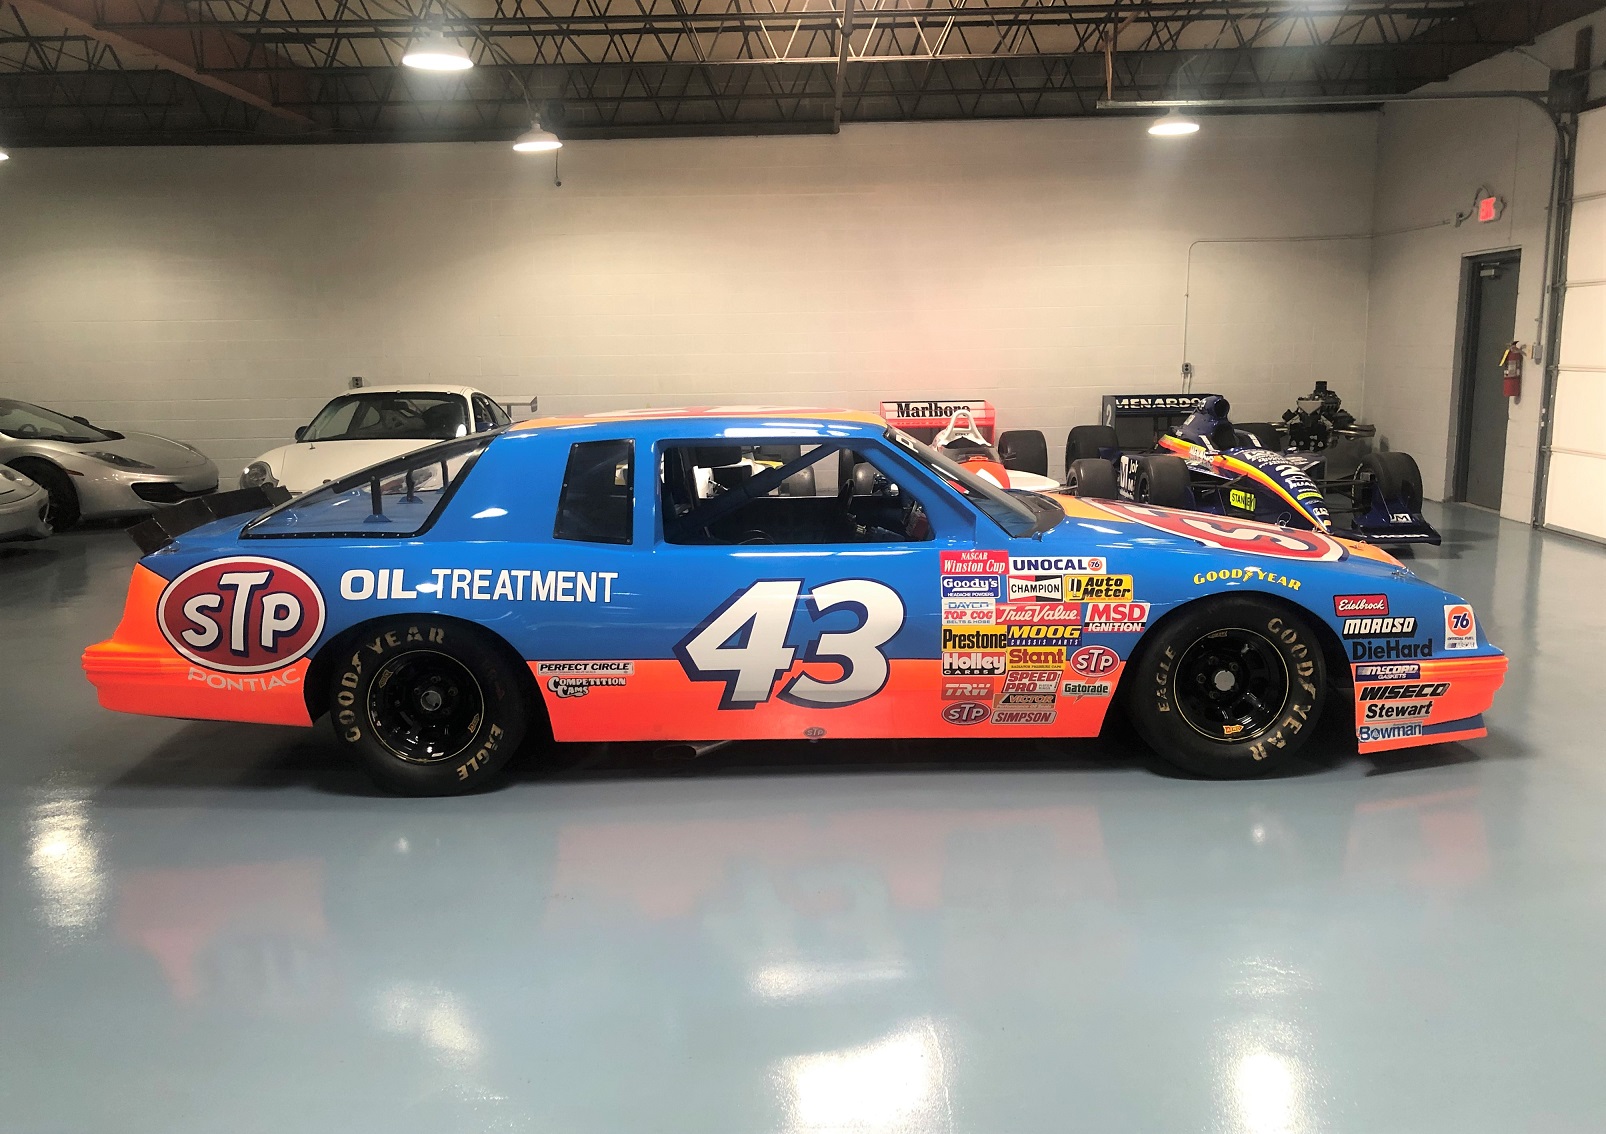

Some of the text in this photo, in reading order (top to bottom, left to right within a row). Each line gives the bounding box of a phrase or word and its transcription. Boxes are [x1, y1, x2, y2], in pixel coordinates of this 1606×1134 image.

[961, 552, 988, 560] NASCAR
[944, 560, 1005, 574] Winston Cup
[1012, 559, 1087, 571] UNOCAL
[340, 569, 619, 603] OIL TREATMENT
[943, 578, 998, 592] Goody's
[1085, 577, 1123, 587] Auto
[1011, 583, 1060, 598] CHAMPION
[1083, 587, 1131, 597] Meter
[1089, 604, 1146, 621] MSD
[1338, 599, 1385, 611] Edelbrock
[181, 570, 304, 658] STP
[944, 611, 993, 619] TOP COG
[1453, 613, 1469, 628] 76
[1008, 626, 1082, 638] MOOG
[1087, 623, 1142, 632] IGNITION
[1343, 618, 1416, 637] MOROSO
[671, 577, 907, 711] 43
[943, 629, 1007, 649] Prestone
[1009, 649, 1064, 664] Stant
[1353, 638, 1433, 660] DieHard
[540, 663, 630, 671] PERFECT CIRCLE
[943, 653, 1005, 674] Holley
[1076, 649, 1113, 672] STP
[187, 667, 303, 692] PONTIAC
[1008, 672, 1058, 682] SPEED
[1156, 646, 1176, 713] EAGLE
[945, 683, 991, 696] TRW
[1004, 682, 1038, 692] PRO
[1064, 683, 1109, 693] Gatorade
[1359, 683, 1451, 701] WISECO
[949, 704, 984, 721] STP
[995, 712, 1052, 722] SIMPSON
[1365, 701, 1433, 719] Stewart
[456, 723, 504, 782] EAGLE
